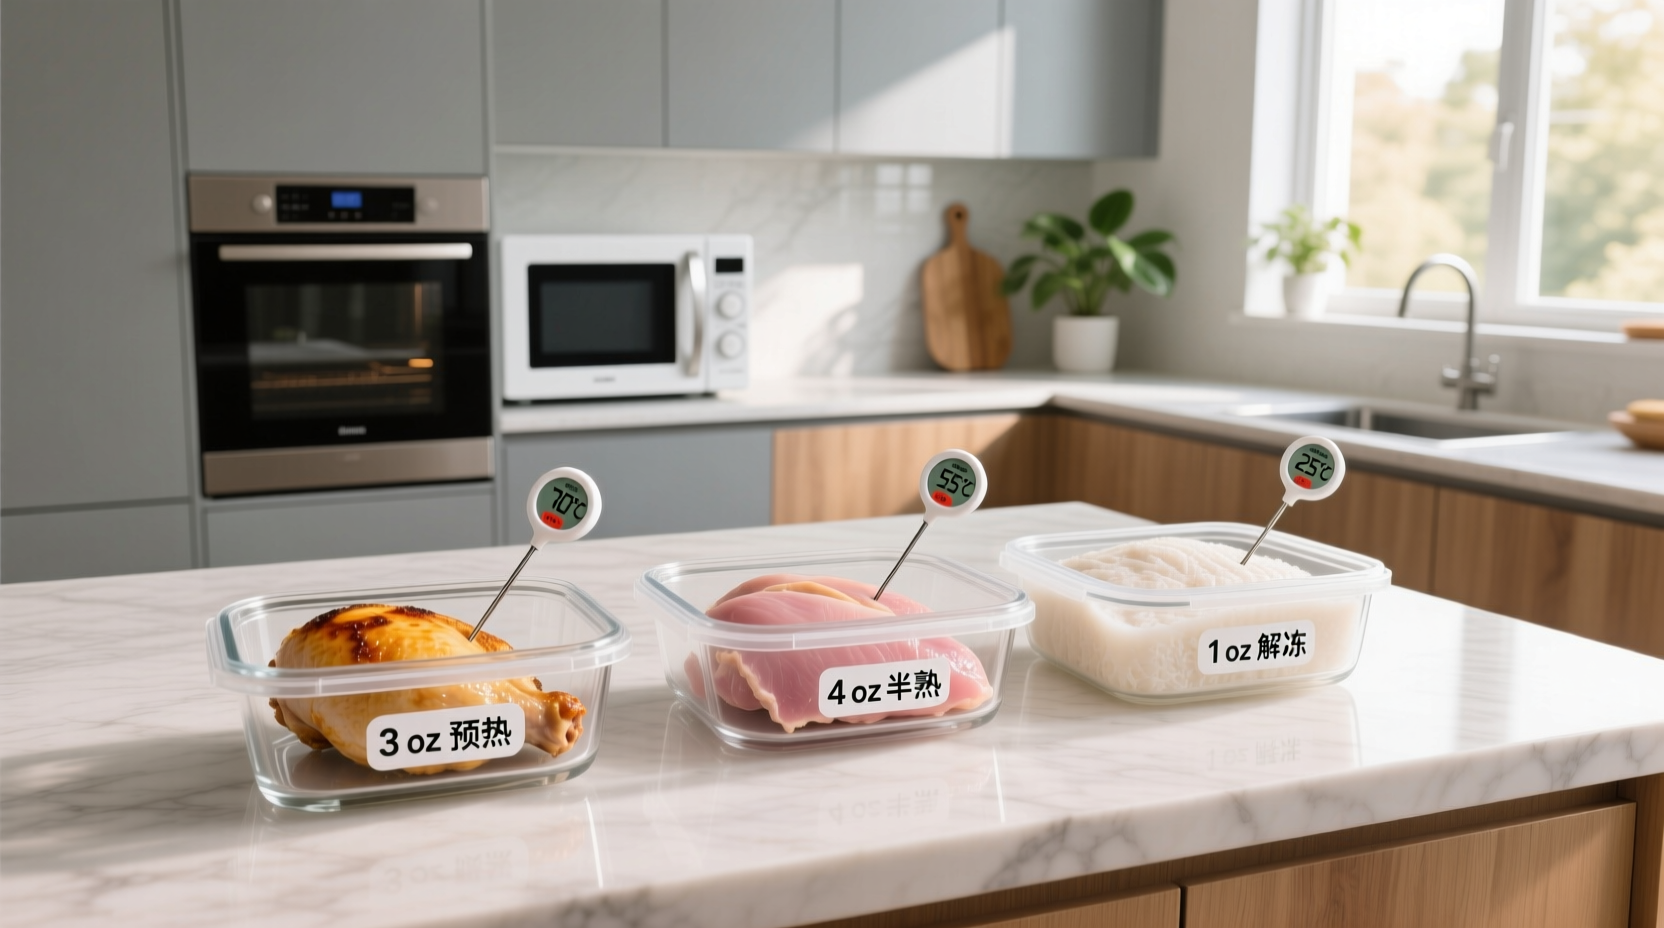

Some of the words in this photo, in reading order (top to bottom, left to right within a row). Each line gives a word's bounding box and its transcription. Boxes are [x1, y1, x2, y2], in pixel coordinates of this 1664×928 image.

[1208, 639, 1219, 664] 1
[1225, 643, 1252, 662] oz
[1257, 628, 1307, 661] 解冻
[827, 679, 846, 705] 4
[851, 683, 882, 703] oz
[886, 668, 942, 701] 半熟
[379, 727, 399, 757] 3
[407, 732, 442, 754] oz
[449, 715, 512, 751] 预热
